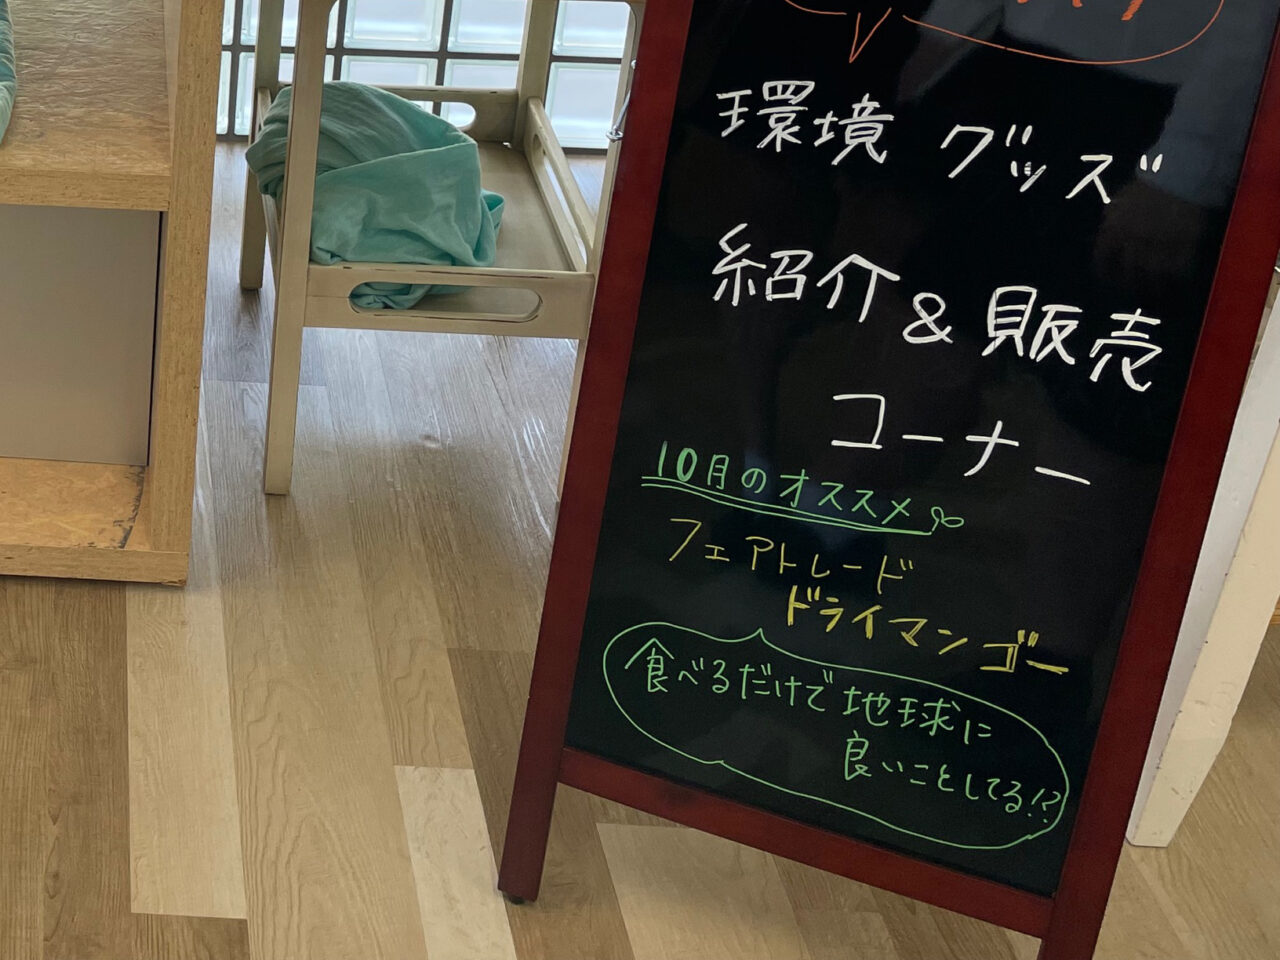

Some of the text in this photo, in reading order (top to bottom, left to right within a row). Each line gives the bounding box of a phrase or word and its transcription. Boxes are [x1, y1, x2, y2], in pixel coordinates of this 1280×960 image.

[656, 441, 913, 526] 10月のオススメ
[831, 393, 1091, 486] コーナー
[669, 517, 915, 595] フェアトレード
[787, 584, 1070, 676] ドライマンゴー
[843, 730, 1062, 825] 良いことしてる!?
